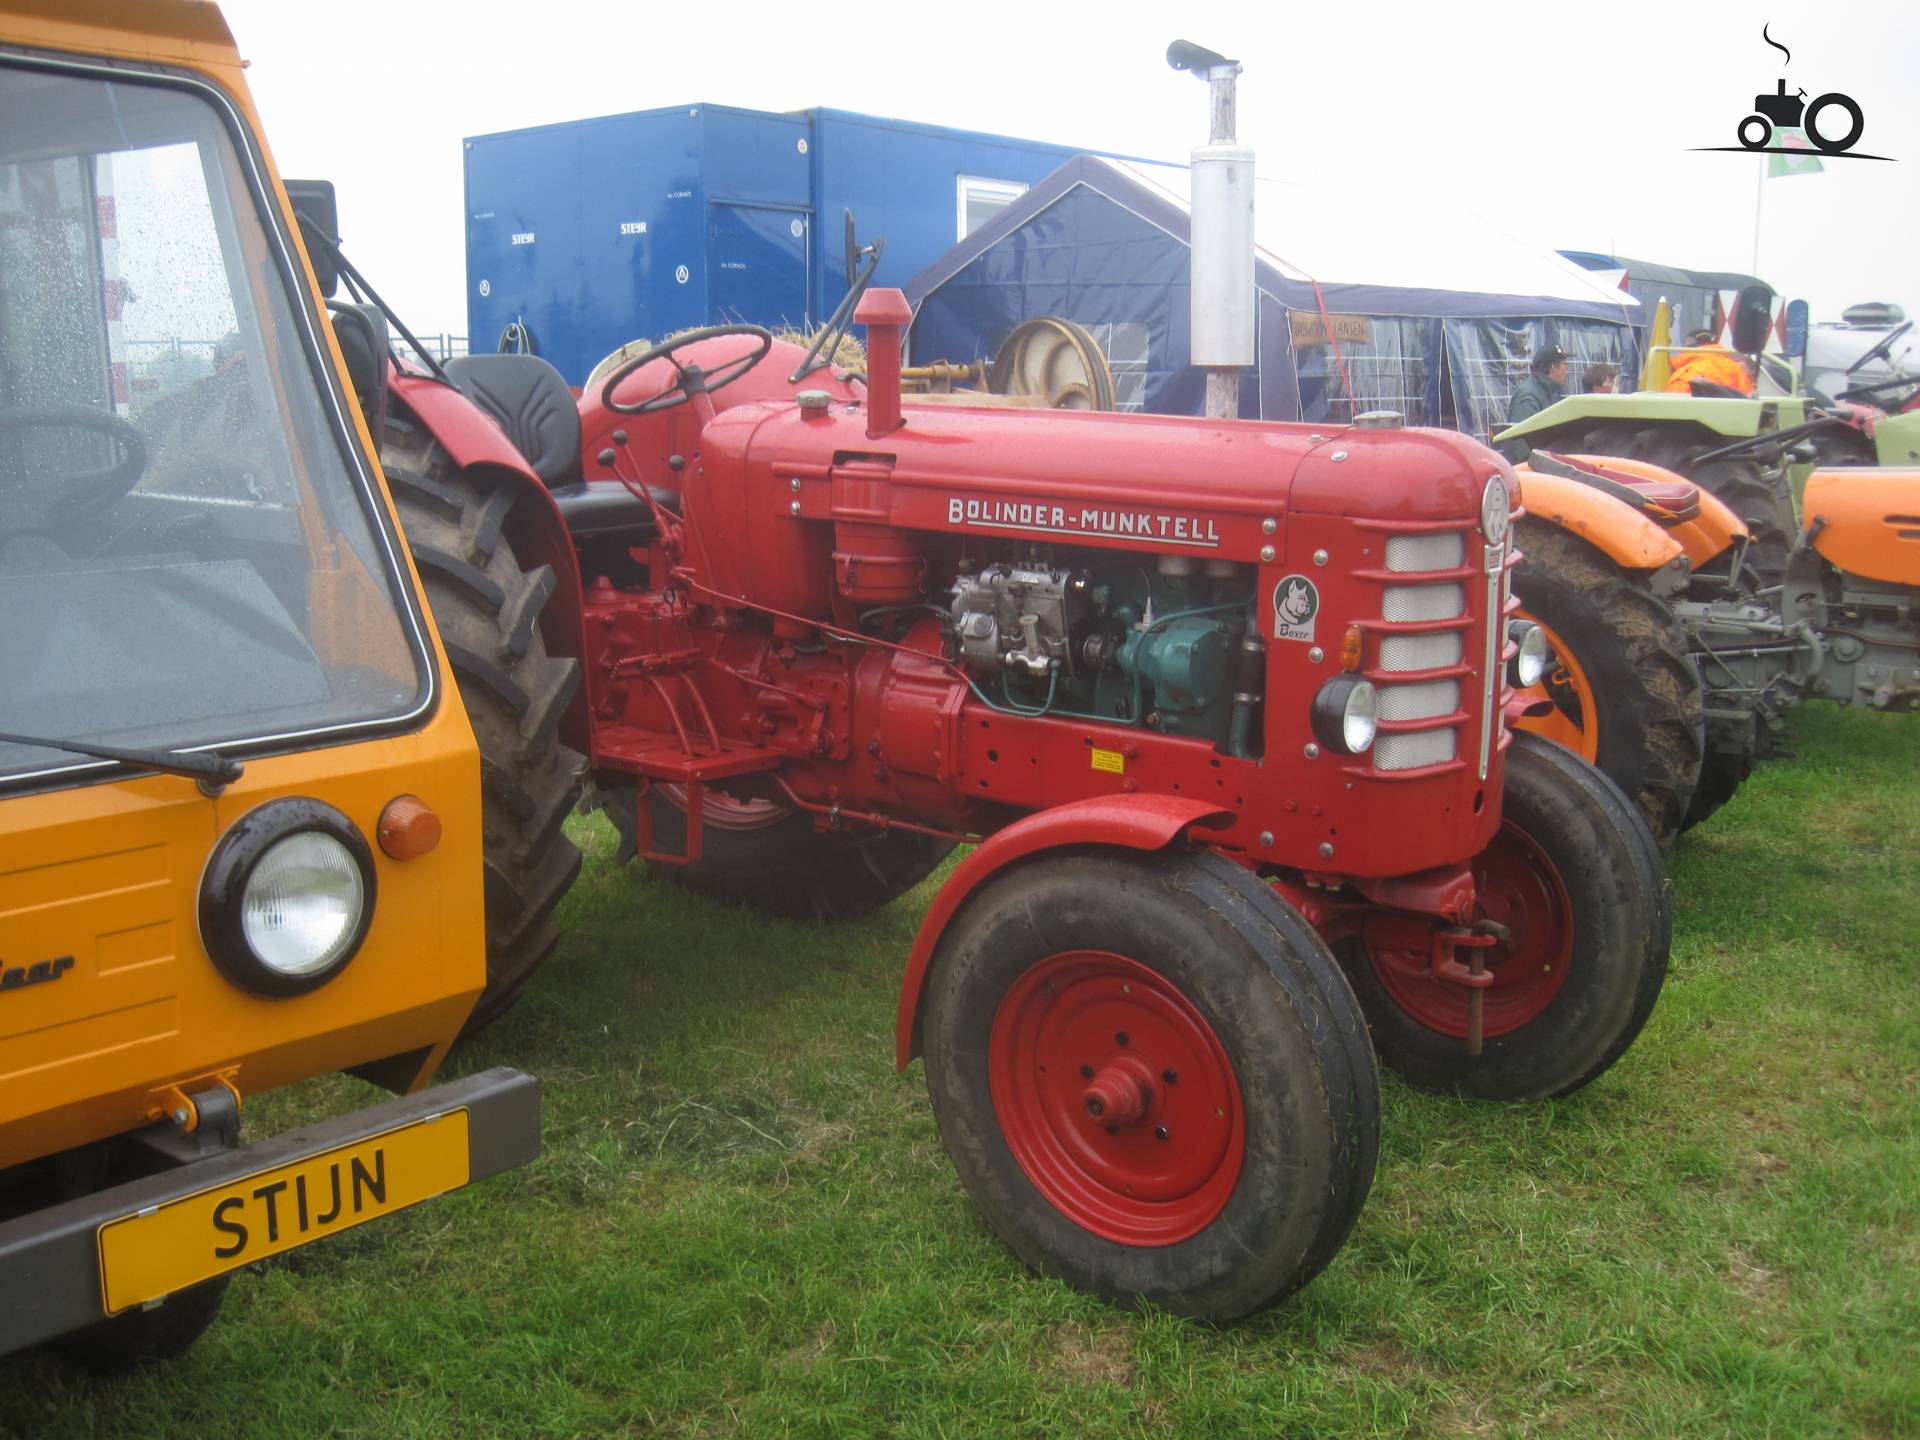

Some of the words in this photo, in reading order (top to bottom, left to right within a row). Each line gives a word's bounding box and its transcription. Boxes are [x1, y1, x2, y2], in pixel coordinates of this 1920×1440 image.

[619, 221, 647, 235] STEYR
[512, 232, 535, 245] STEYR
[948, 498, 1219, 541] BOLINDER-MUNKTELL
[1279, 622, 1310, 639] Boxer
[212, 1148, 388, 1259] STIJN
